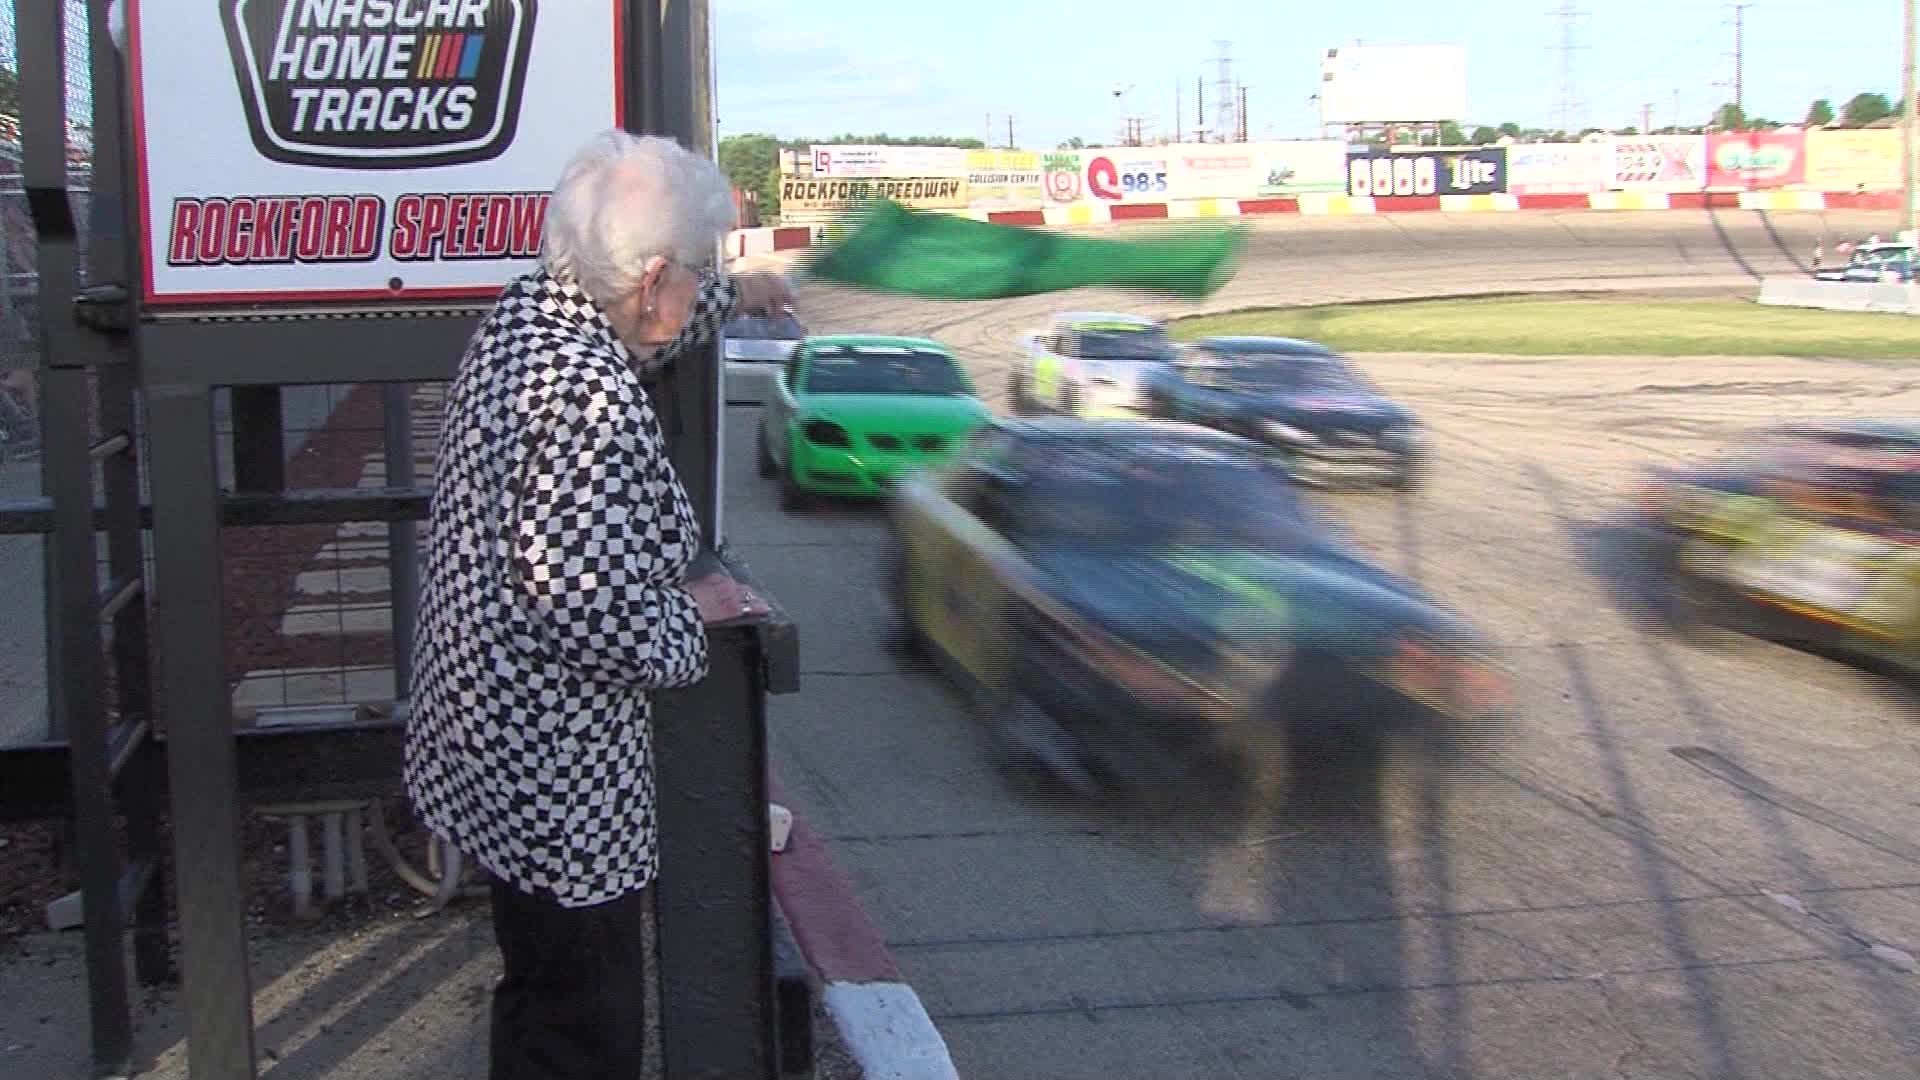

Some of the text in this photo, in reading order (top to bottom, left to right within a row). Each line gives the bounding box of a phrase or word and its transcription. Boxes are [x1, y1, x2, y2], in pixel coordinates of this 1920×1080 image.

[297, 0, 490, 28] NASCAR
[269, 34, 416, 80] HOME
[290, 86, 478, 132] TRACKS
[782, 180, 960, 201] ROCKFORD SPEEDWAY
[968, 174, 1040, 184] COLLISION CENTER
[168, 190, 552, 267] ROCKFORD SPEEDW
